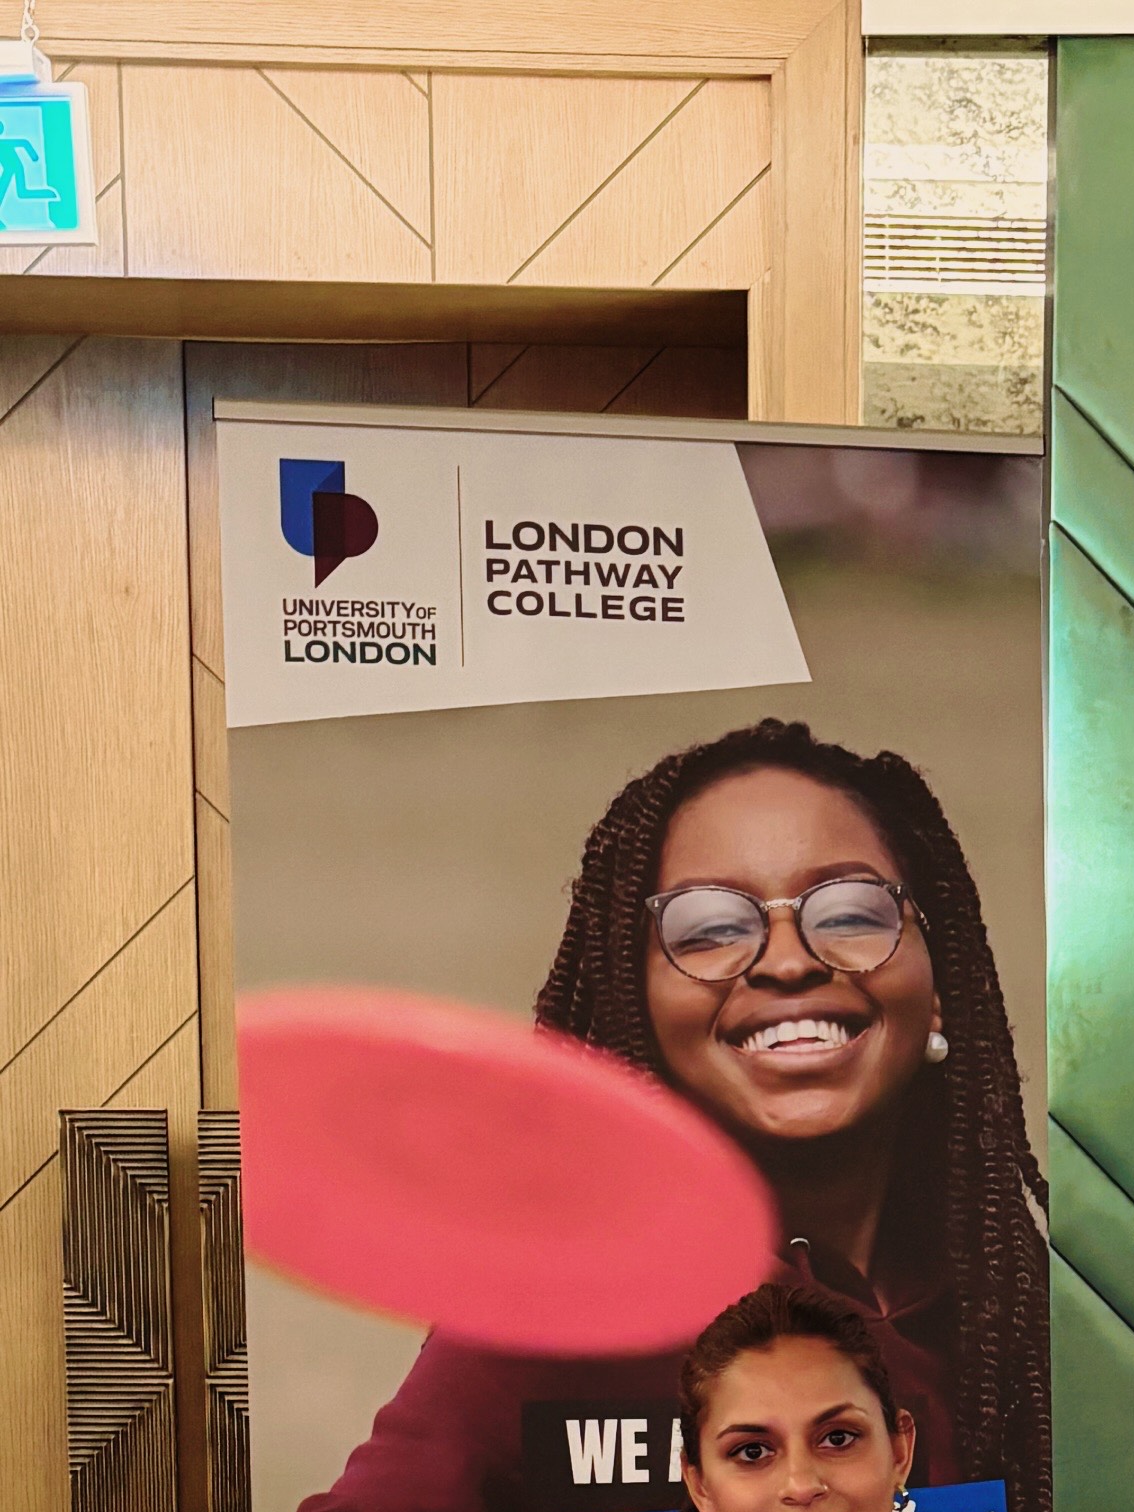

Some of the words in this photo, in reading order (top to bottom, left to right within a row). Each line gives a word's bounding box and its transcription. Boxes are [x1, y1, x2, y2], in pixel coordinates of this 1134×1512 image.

[484, 520, 684, 557] LONDON
[486, 557, 684, 590] PATHWAY
[282, 598, 415, 619] UNIVERSITY
[487, 590, 686, 622] COLLEGE
[283, 618, 436, 640] PORTSMOUTH
[284, 640, 436, 666] LONDON
[566, 1417, 650, 1485] WE
